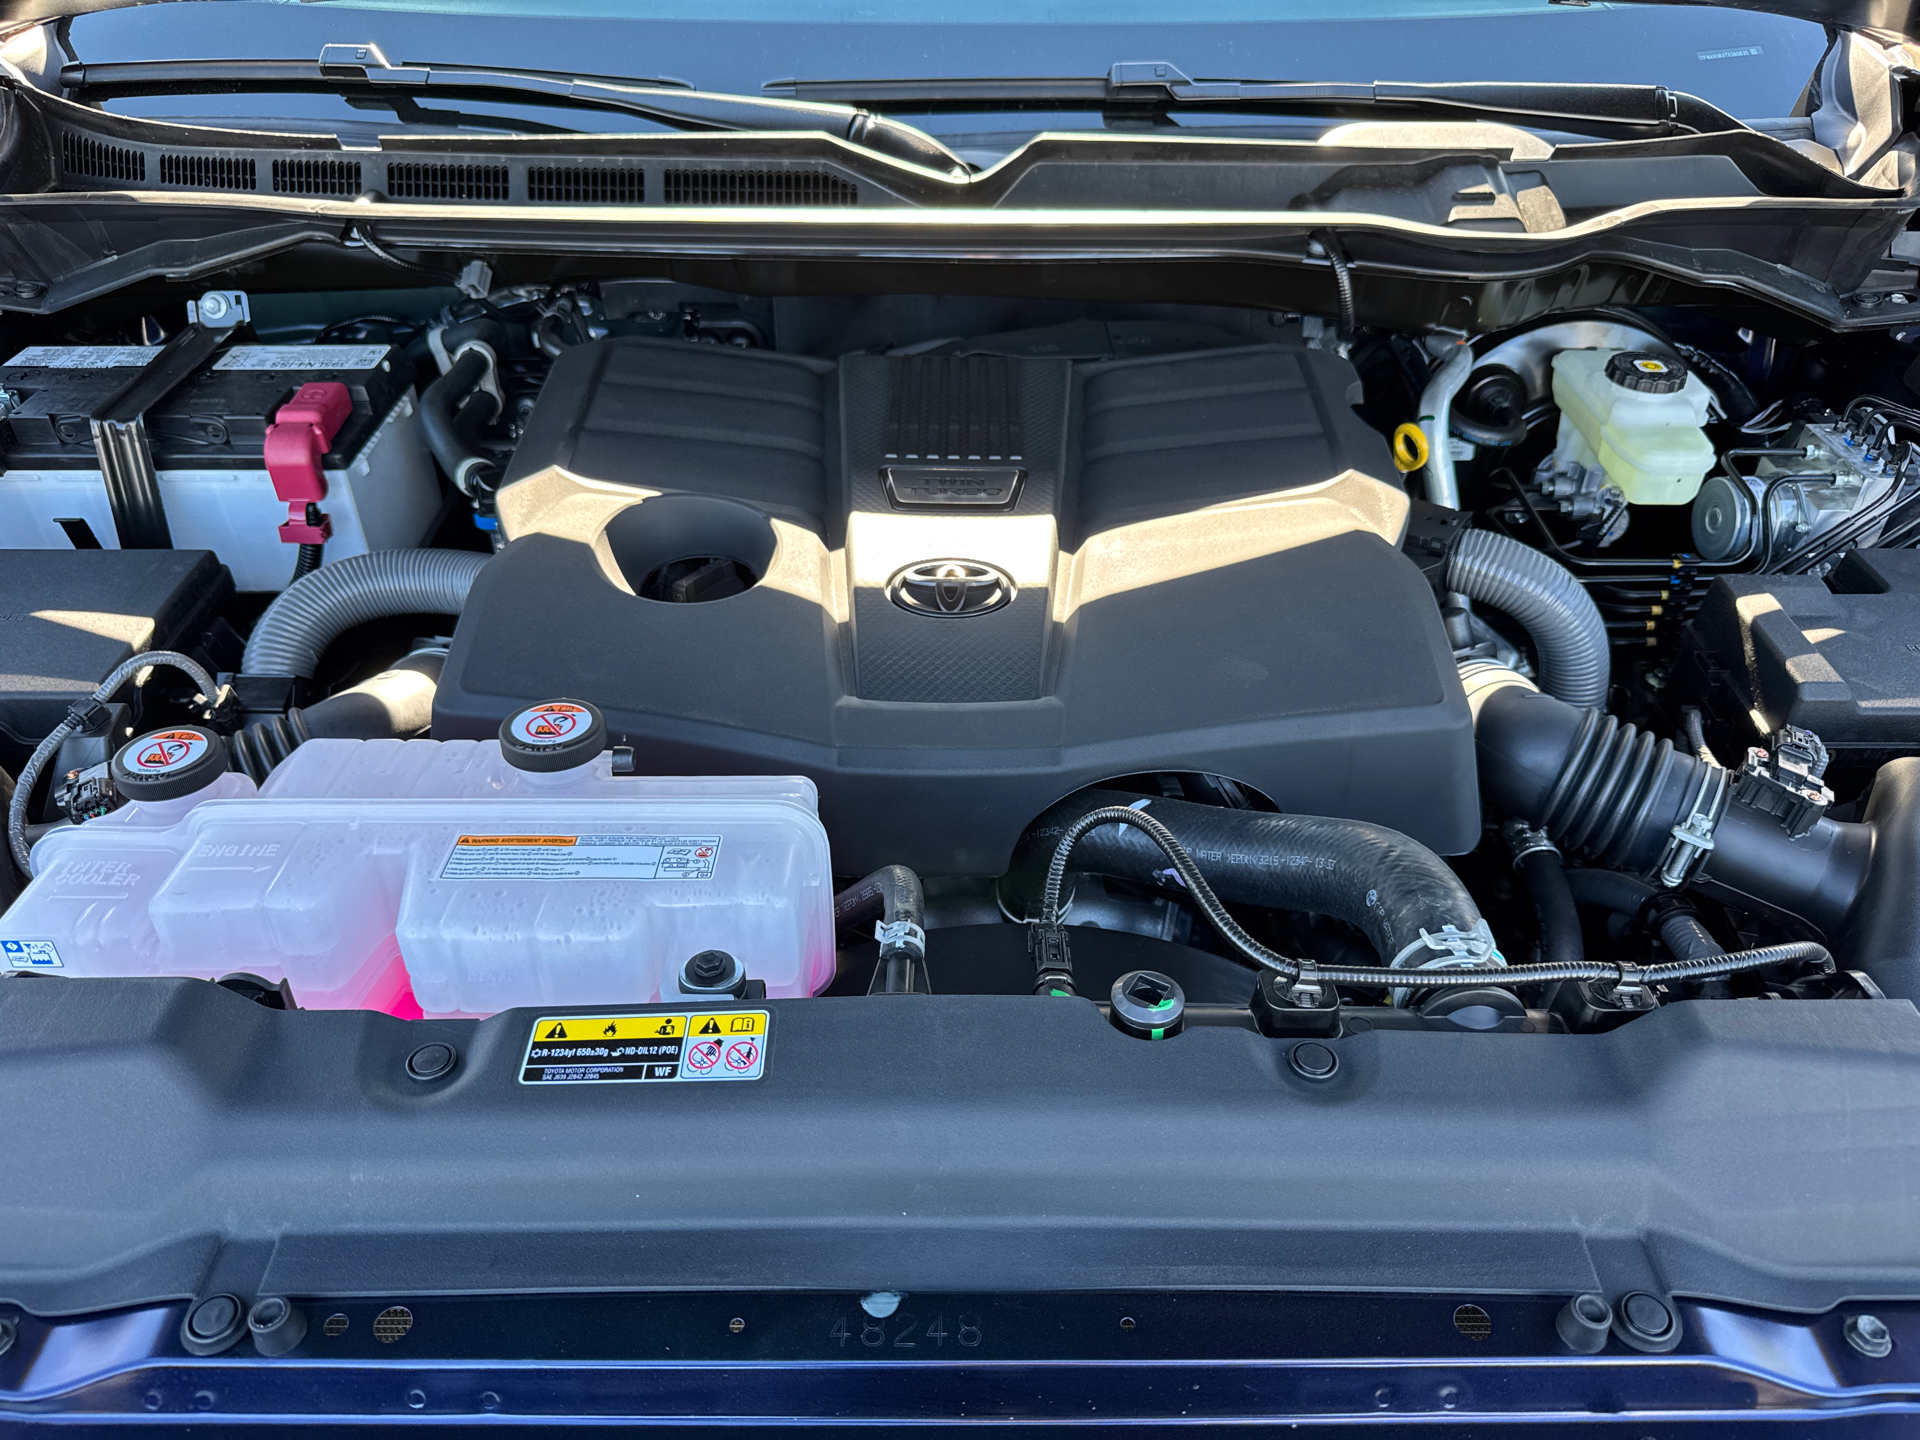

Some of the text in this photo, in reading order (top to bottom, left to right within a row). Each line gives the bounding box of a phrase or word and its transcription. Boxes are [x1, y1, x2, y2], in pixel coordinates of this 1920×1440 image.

[917, 477, 986, 486] TWIN
[904, 486, 1003, 496] TURBO
[197, 843, 281, 858] ENGINE
[1196, 848, 1222, 862] WATER
[60, 860, 133, 874] INTER
[54, 872, 141, 887] COOLER
[541, 1048, 576, 1058] R-1234yf
[576, 1047, 609, 1057] 650±30g
[658, 1045, 679, 1056] (POE)
[654, 1066, 673, 1077] WF
[829, 1312, 982, 1348] 48248
